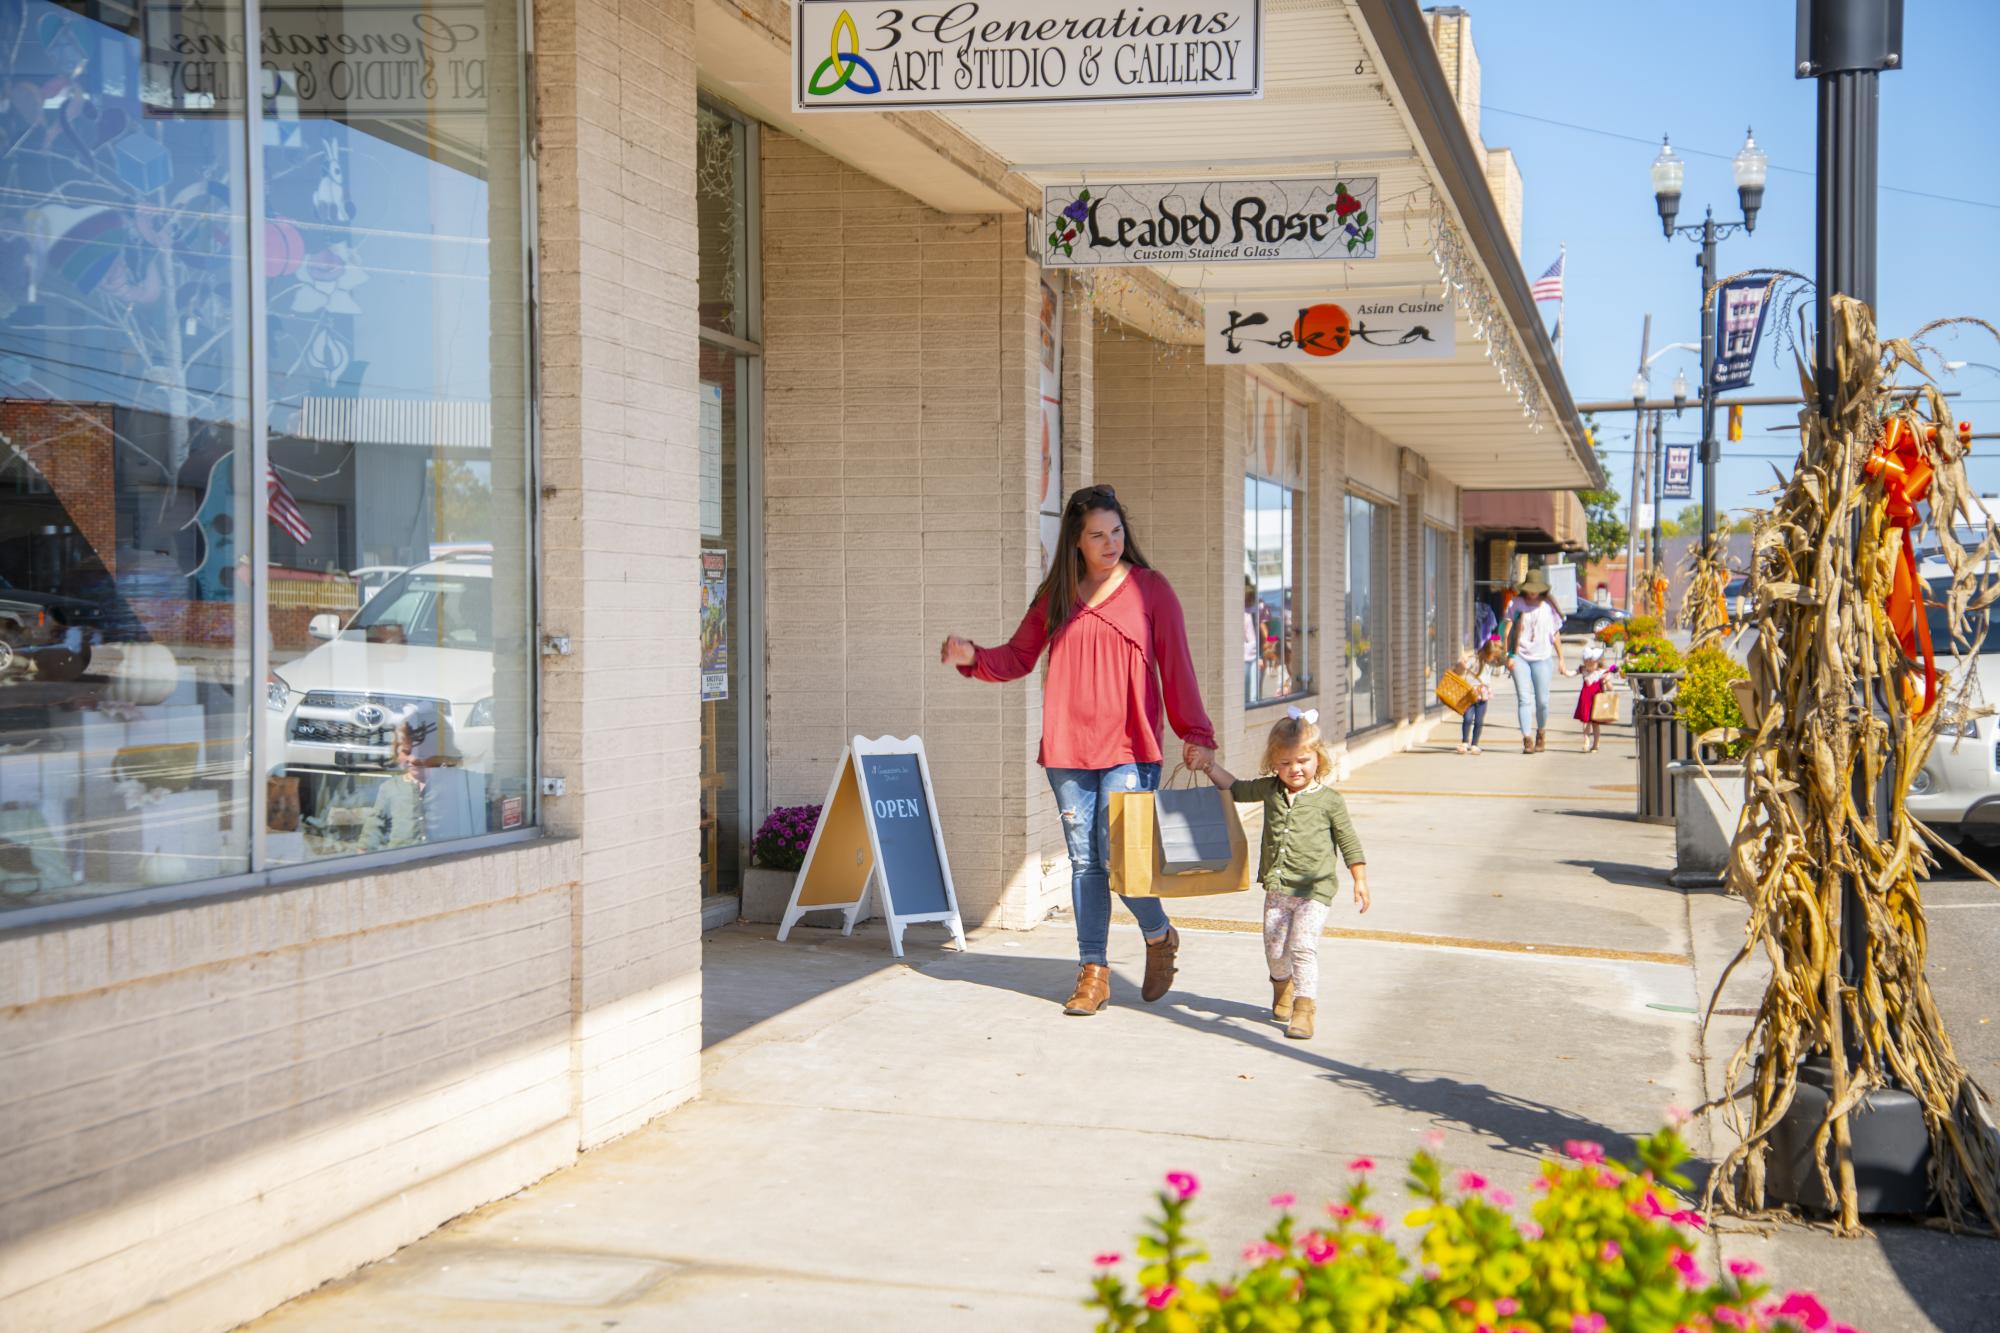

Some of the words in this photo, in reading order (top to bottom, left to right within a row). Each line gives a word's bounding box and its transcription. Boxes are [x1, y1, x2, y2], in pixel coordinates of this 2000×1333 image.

[866, 9, 902, 52] 3
[911, 2, 1240, 57] Generations
[886, 49, 944, 91] ART
[953, 46, 1066, 91] STUDIO
[1079, 45, 1103, 86] &
[1114, 40, 1242, 85] GALLERY
[1088, 197, 1221, 249] Leaded
[1231, 197, 1330, 246] Rose
[1133, 248, 1184, 260] Custom
[1188, 247, 1239, 259] Stained
[1243, 246, 1281, 258] Glass
[1357, 304, 1395, 315] Asian
[1398, 302, 1445, 314] Cusine
[875, 798, 920, 819] OPEN
